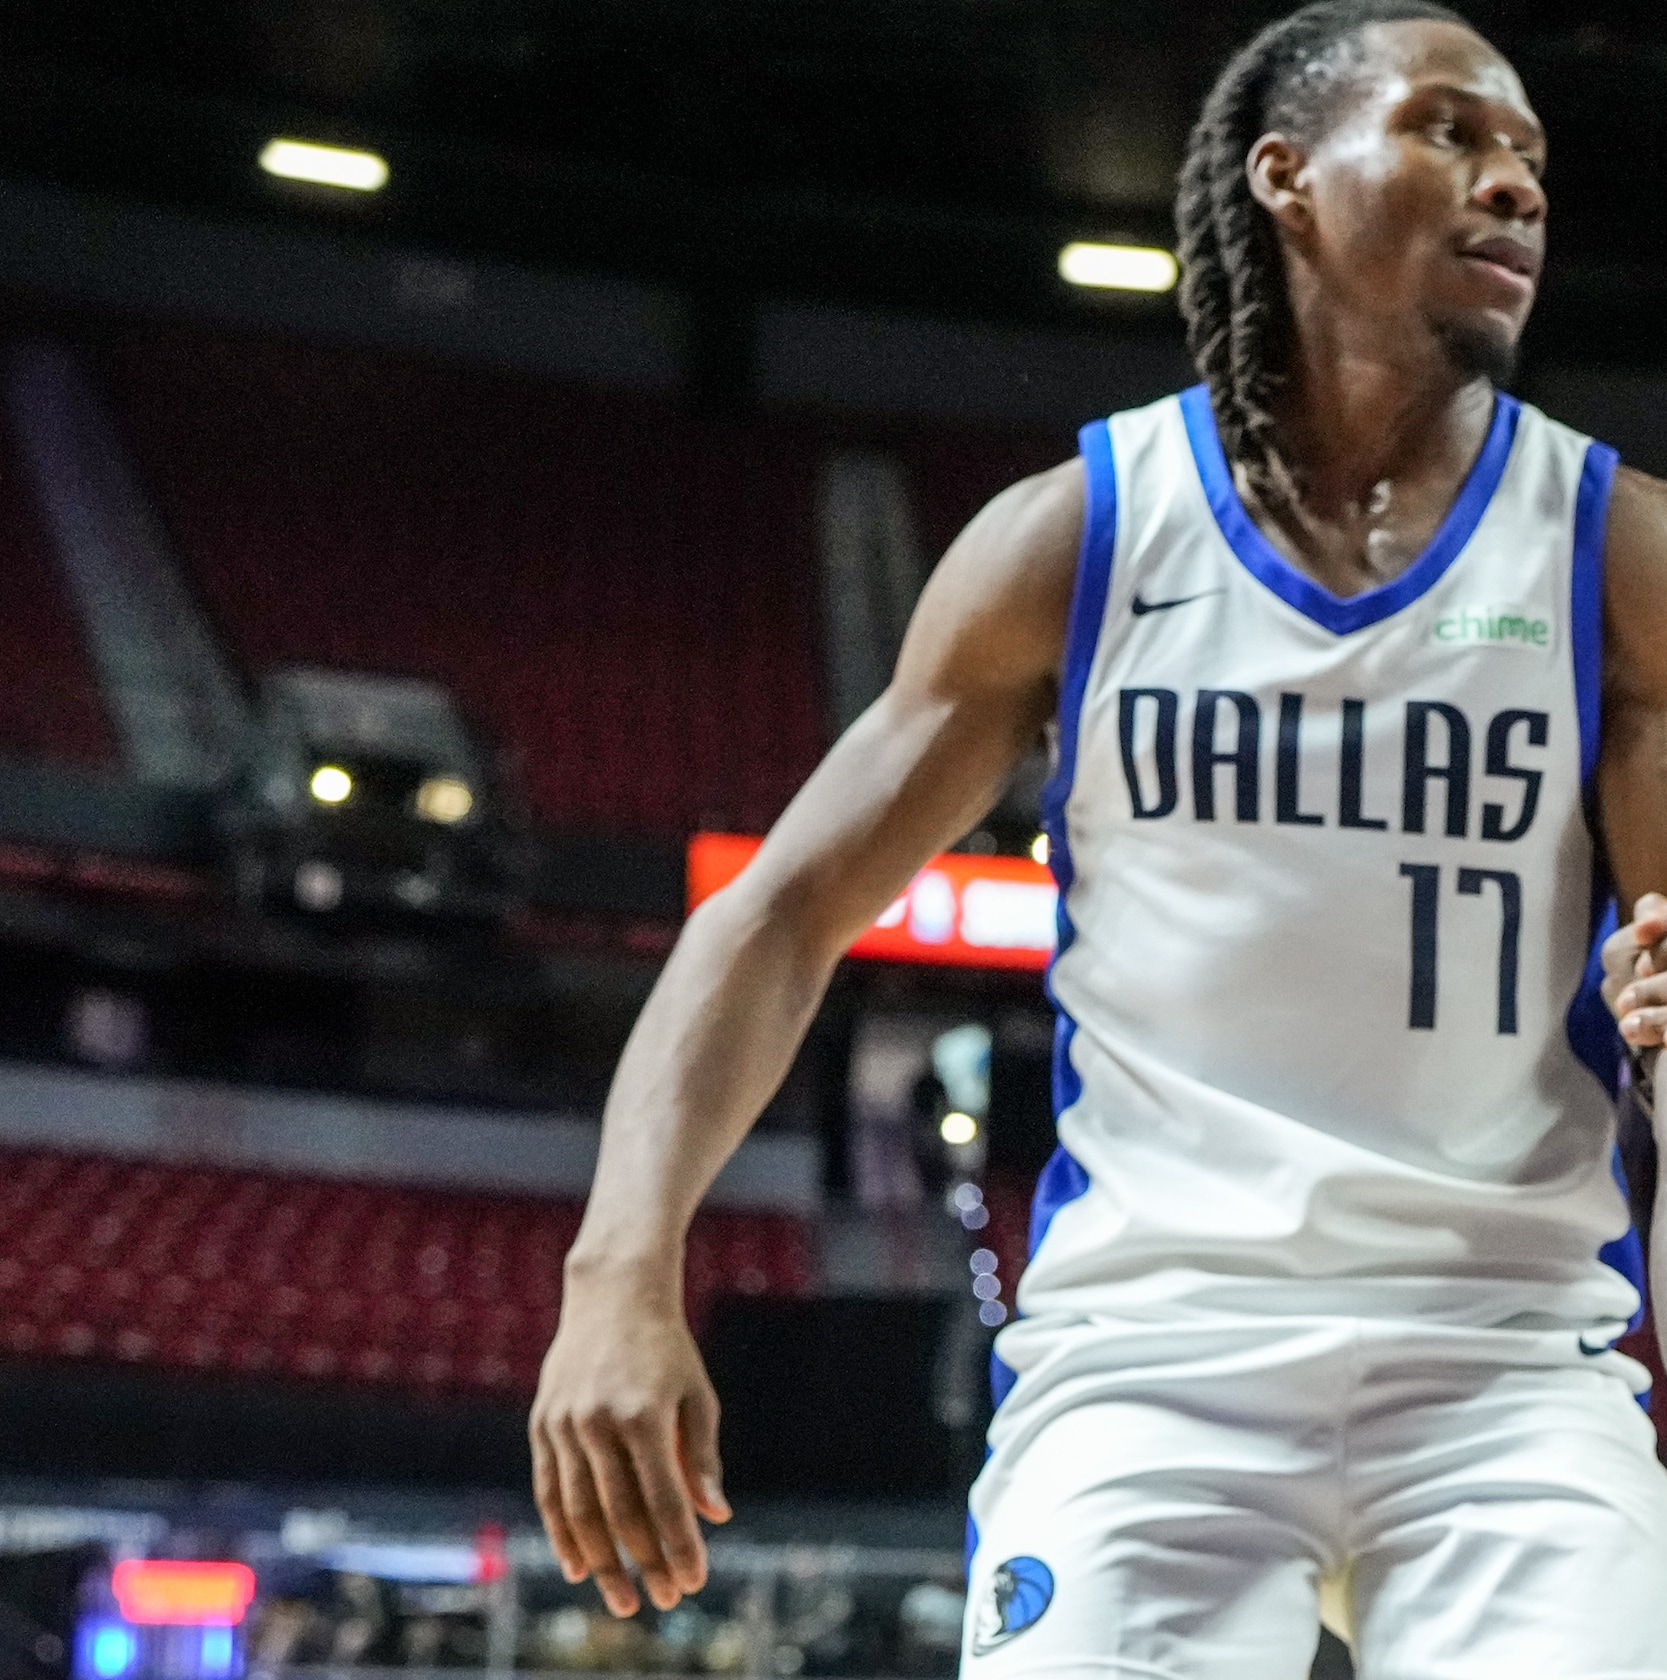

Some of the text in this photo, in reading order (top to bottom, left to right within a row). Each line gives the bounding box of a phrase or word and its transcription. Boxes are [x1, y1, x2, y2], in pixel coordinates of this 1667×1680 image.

[1435, 606, 1549, 647] chime
[1118, 688, 1550, 843] DALLAS
[1400, 863, 1522, 1036] 17
